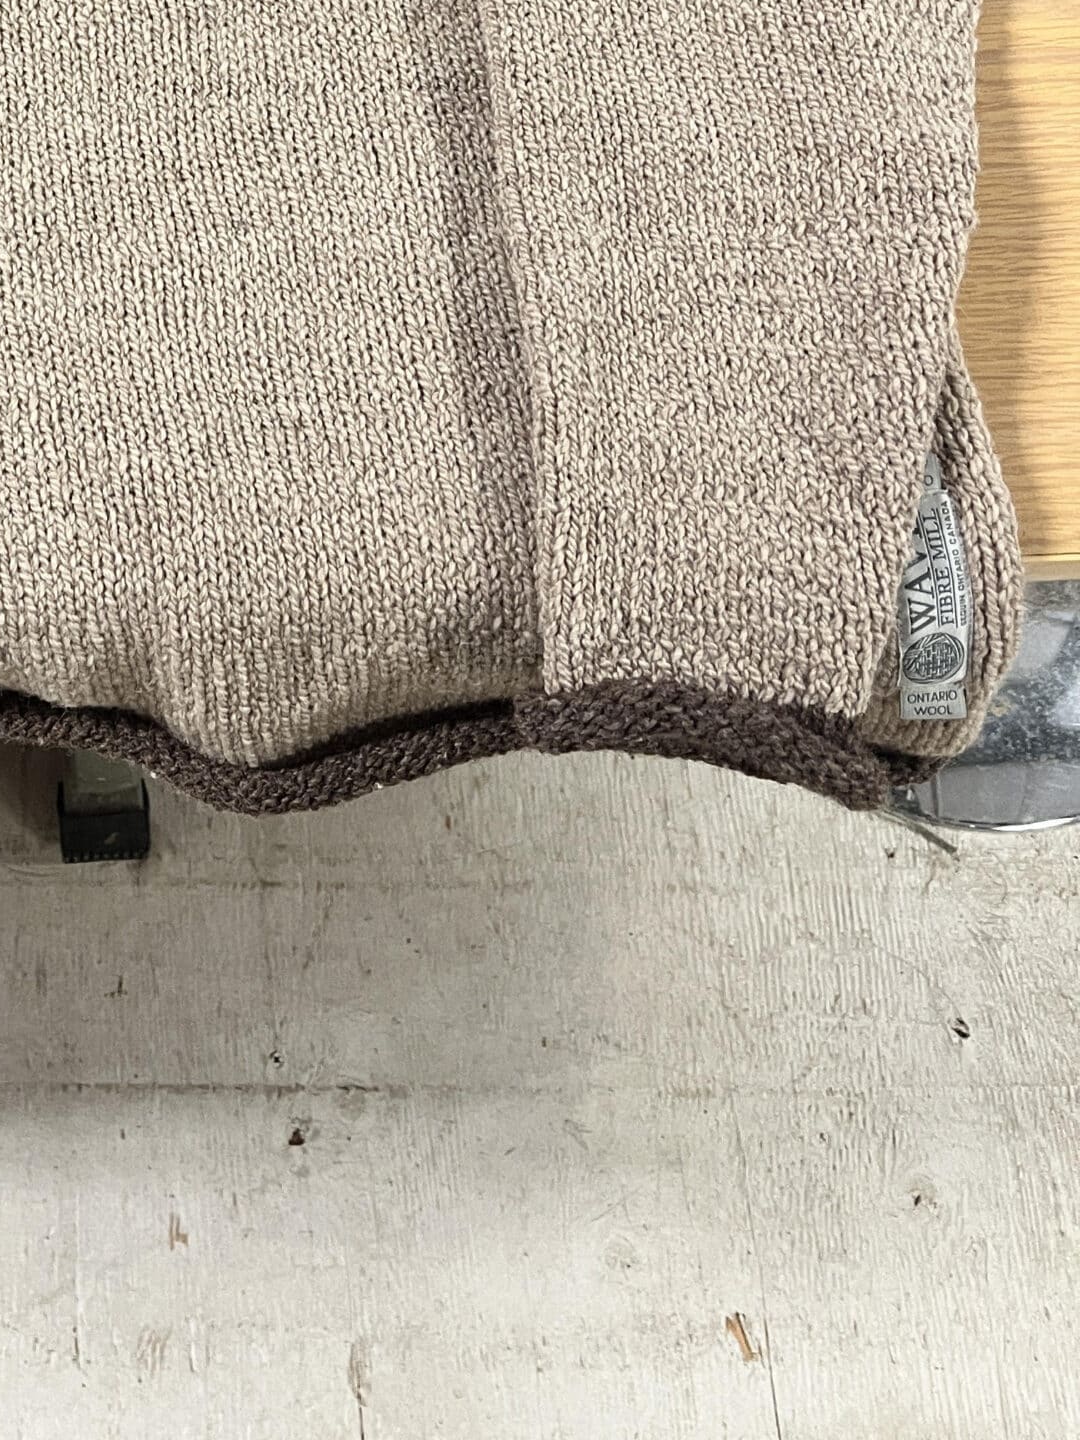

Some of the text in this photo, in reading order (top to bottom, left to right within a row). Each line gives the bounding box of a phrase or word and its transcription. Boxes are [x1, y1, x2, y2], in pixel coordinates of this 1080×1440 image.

[941, 500, 957, 545] CANADA
[922, 508, 954, 626] FIBRE MILL
[907, 689, 957, 704] ONTARIO
[914, 704, 953, 715] WOOL
